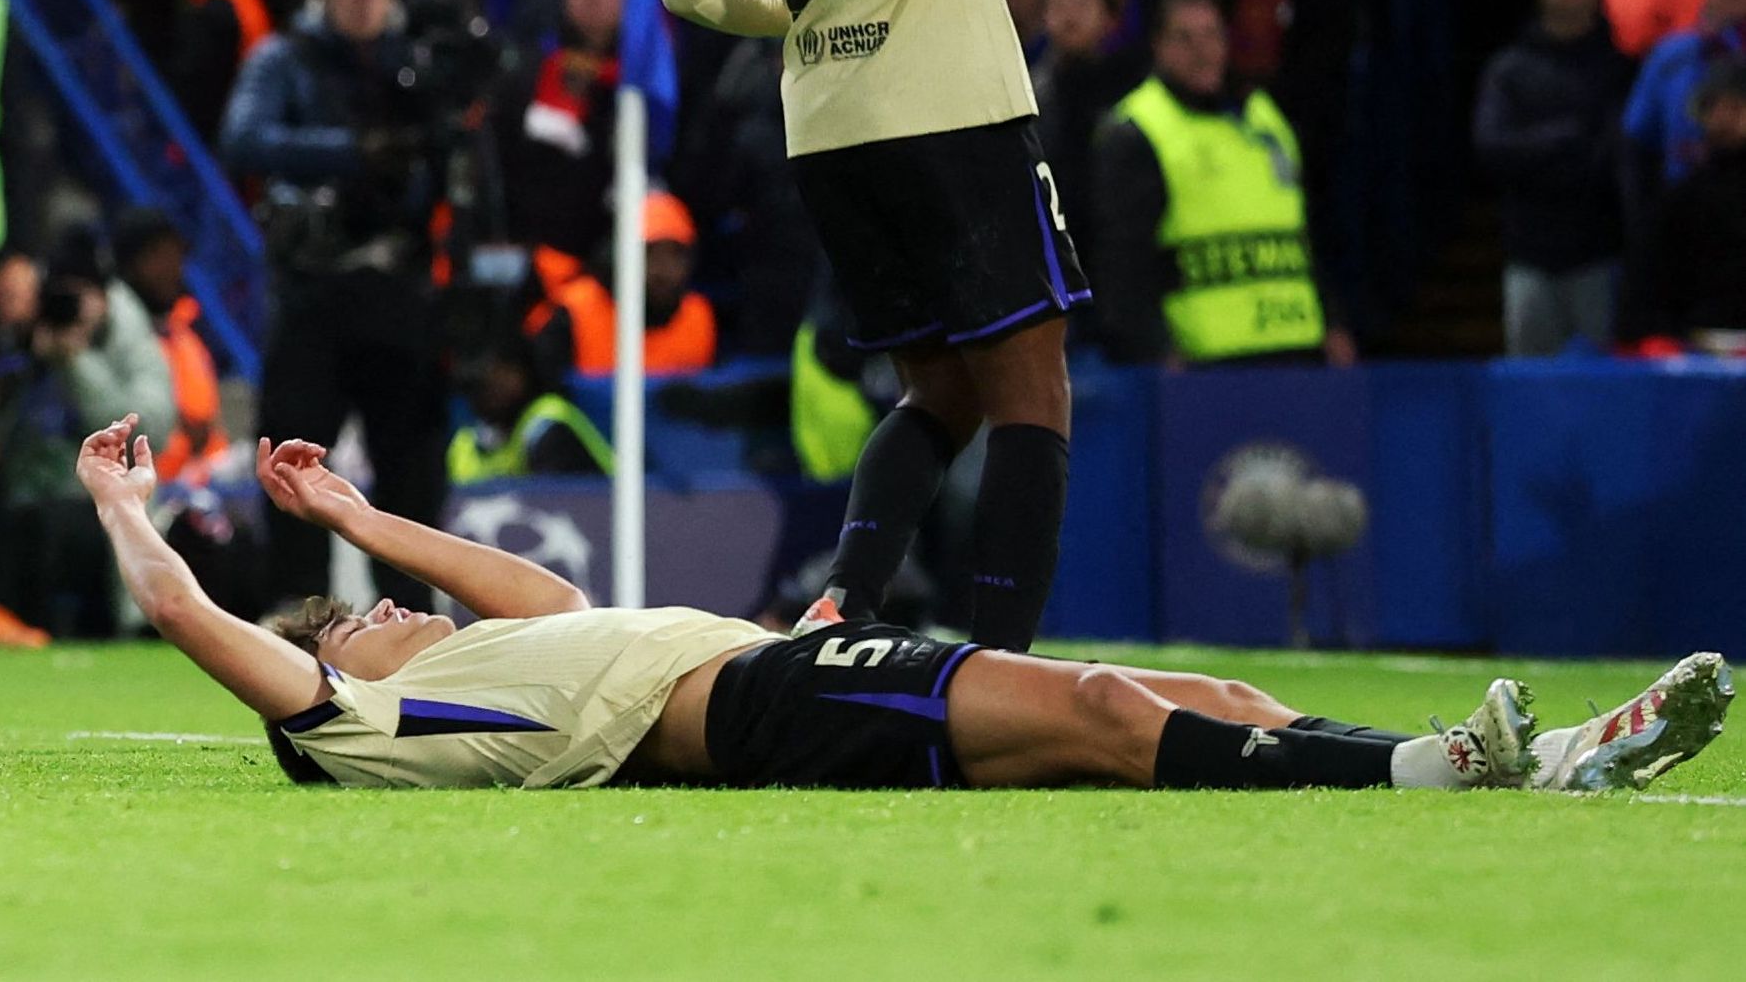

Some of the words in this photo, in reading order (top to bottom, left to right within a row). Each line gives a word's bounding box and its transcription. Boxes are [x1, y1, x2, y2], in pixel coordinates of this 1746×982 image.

[828, 21, 889, 41] UNHCR
[1036, 161, 1066, 231] 2
[814, 637, 895, 667] 5
